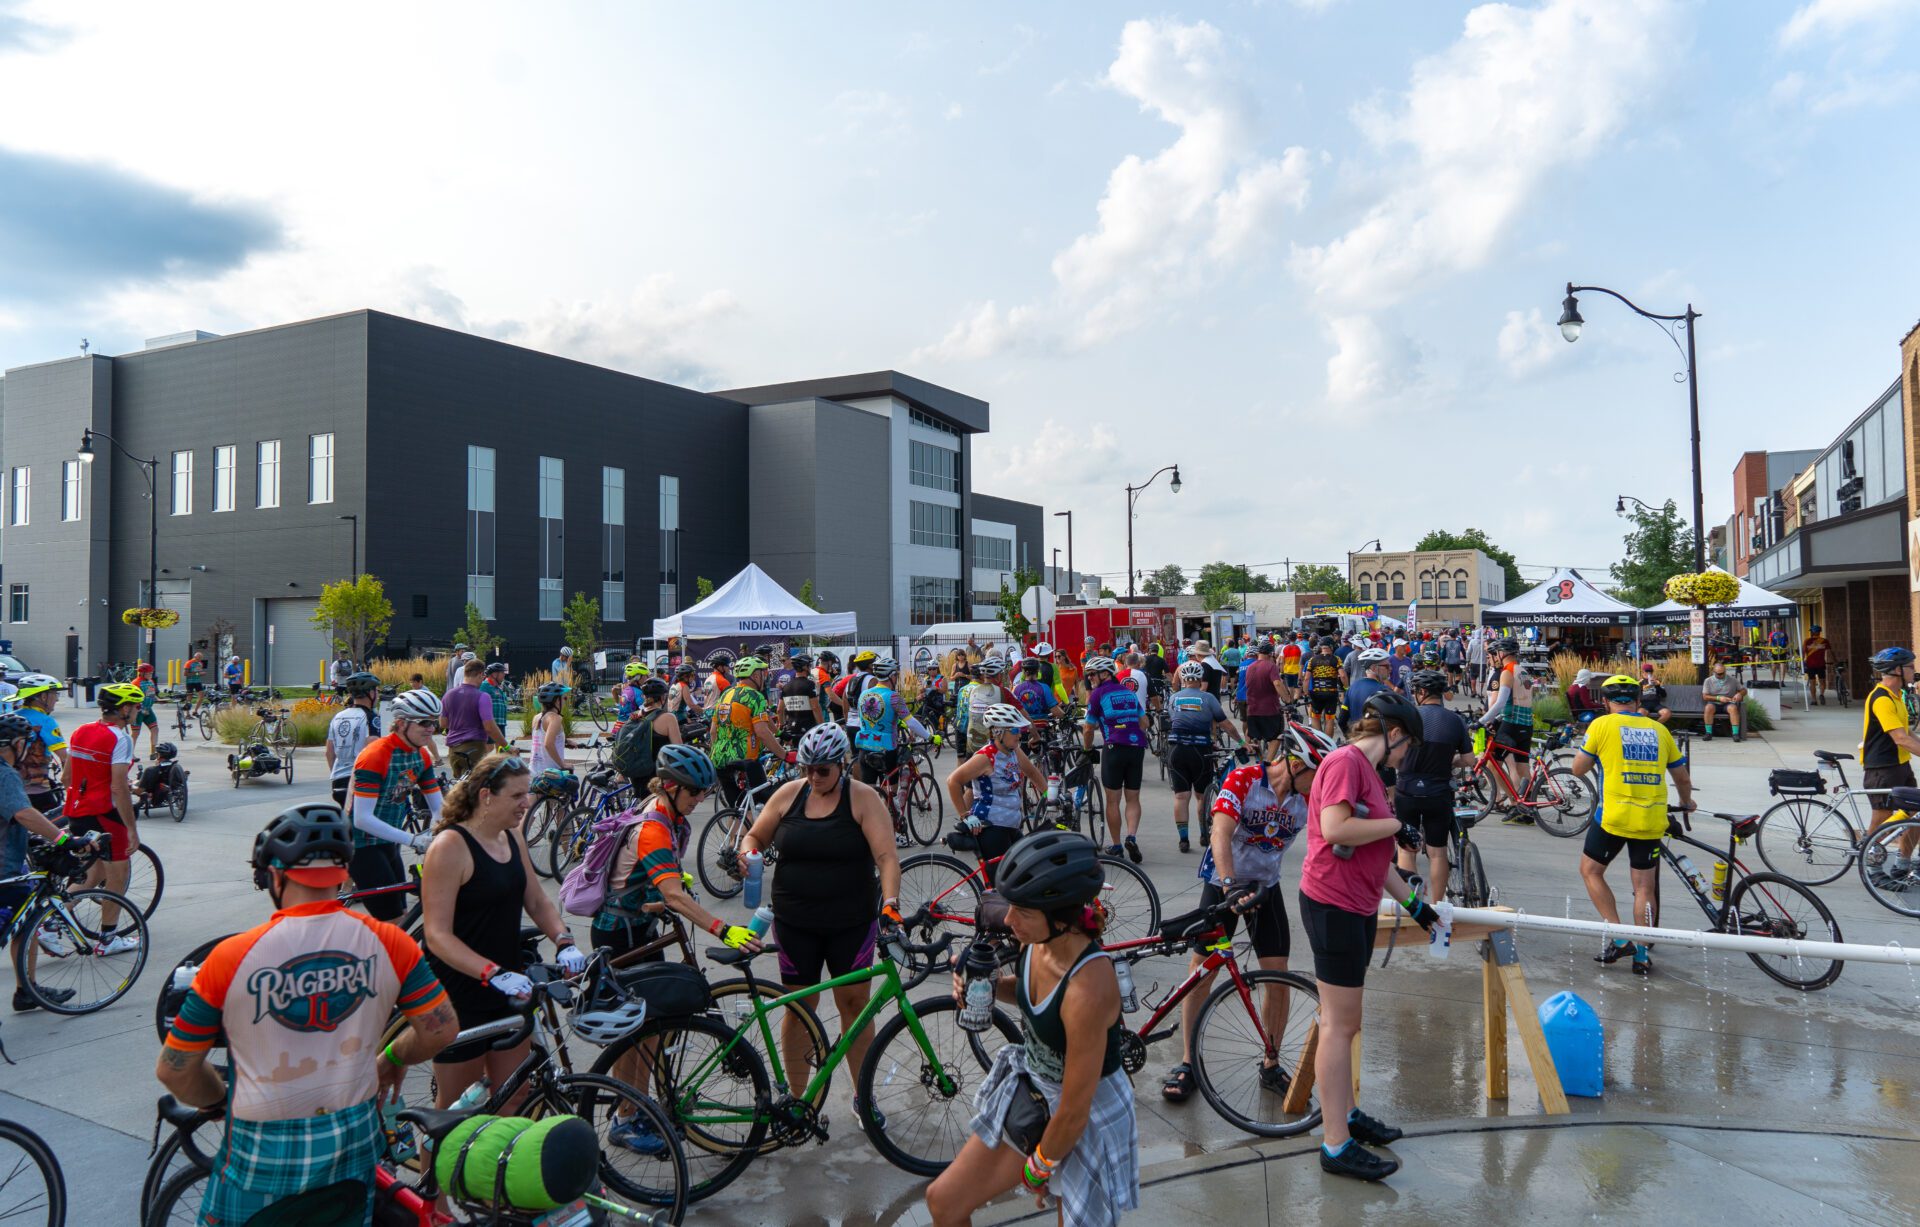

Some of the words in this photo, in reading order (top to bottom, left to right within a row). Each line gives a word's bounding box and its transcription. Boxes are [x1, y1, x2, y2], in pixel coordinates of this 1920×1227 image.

[1506, 614, 1610, 624] www.biketechcf.com
[739, 620, 804, 631] INDIANOLA
[247, 954, 378, 1025] RAGBRAI
